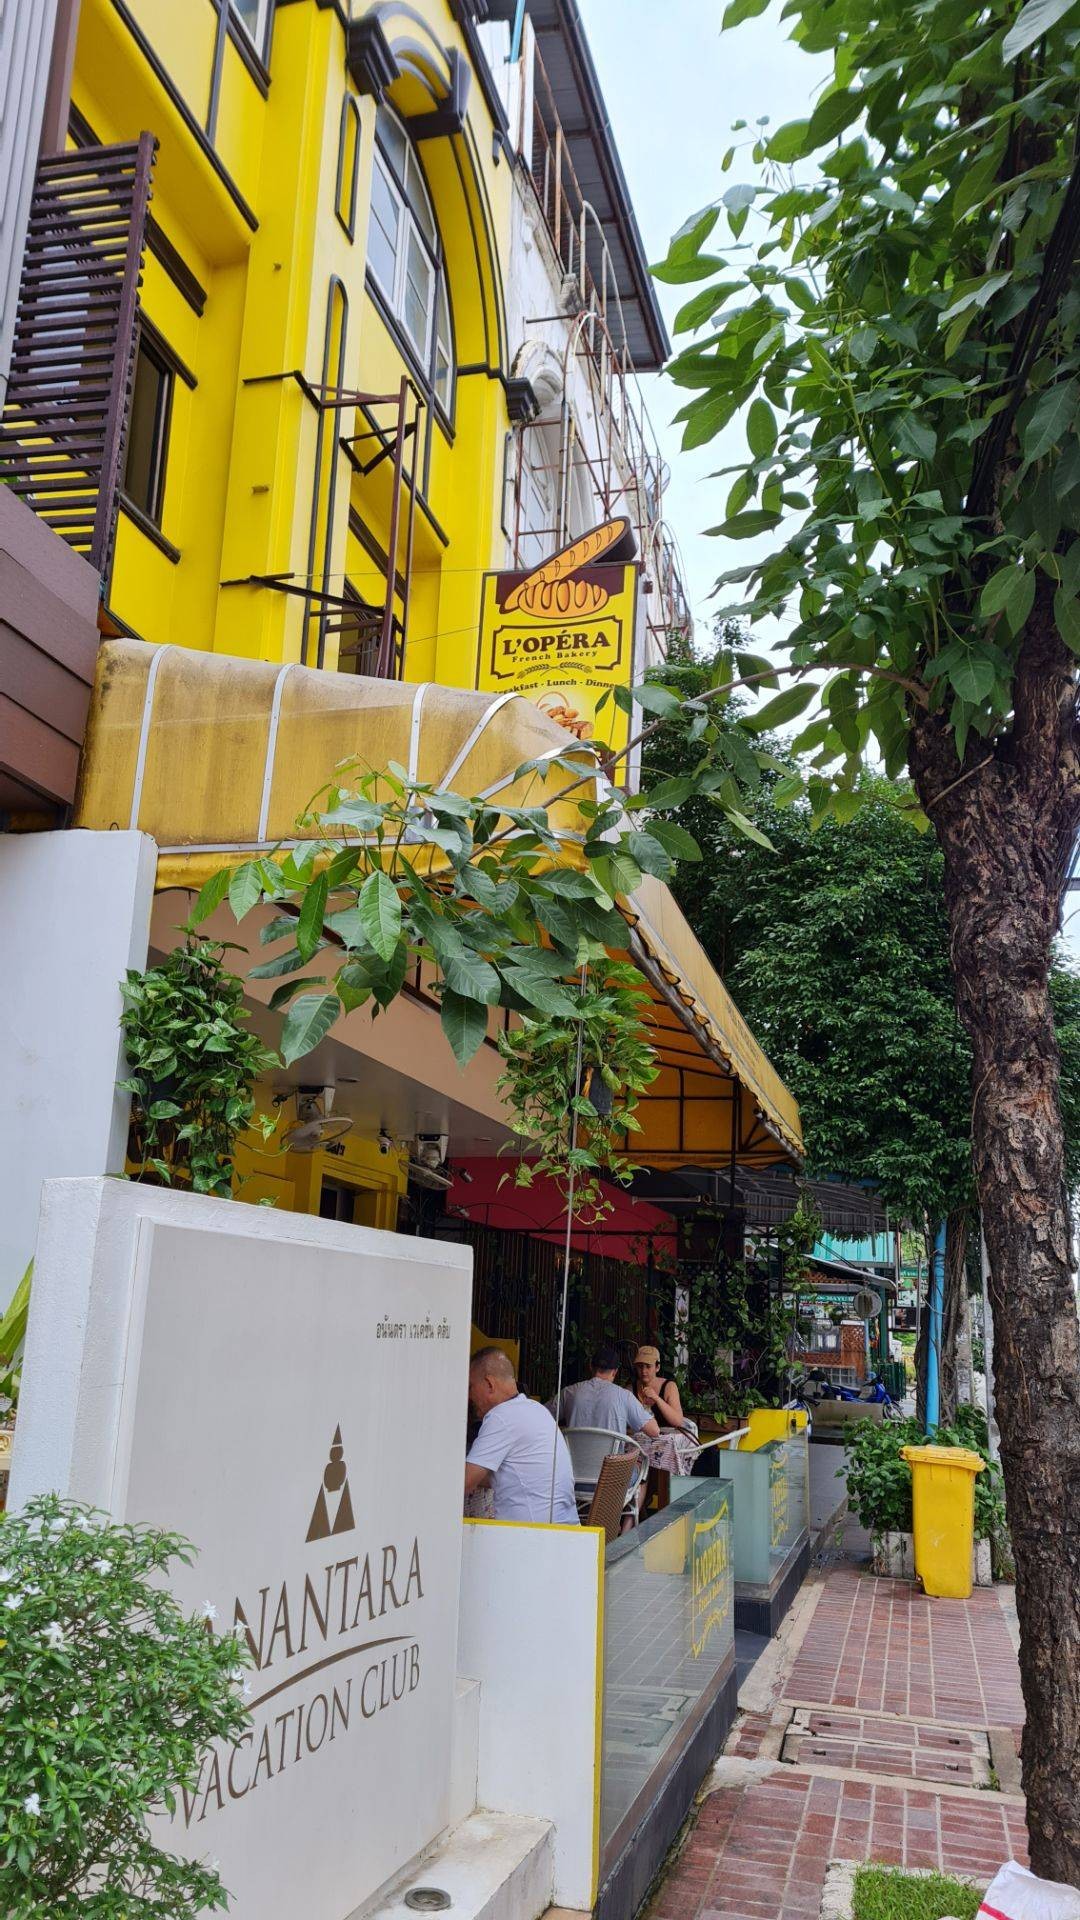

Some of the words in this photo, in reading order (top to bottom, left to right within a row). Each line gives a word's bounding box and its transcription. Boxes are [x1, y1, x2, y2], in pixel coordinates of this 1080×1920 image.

[503, 630, 610, 655] L'OPÉRA
[512, 653, 551, 662] French
[557, 650, 598, 658] Bakery
[547, 679, 577, 687] Lunch
[361, 1643, 420, 1719] CLUB
